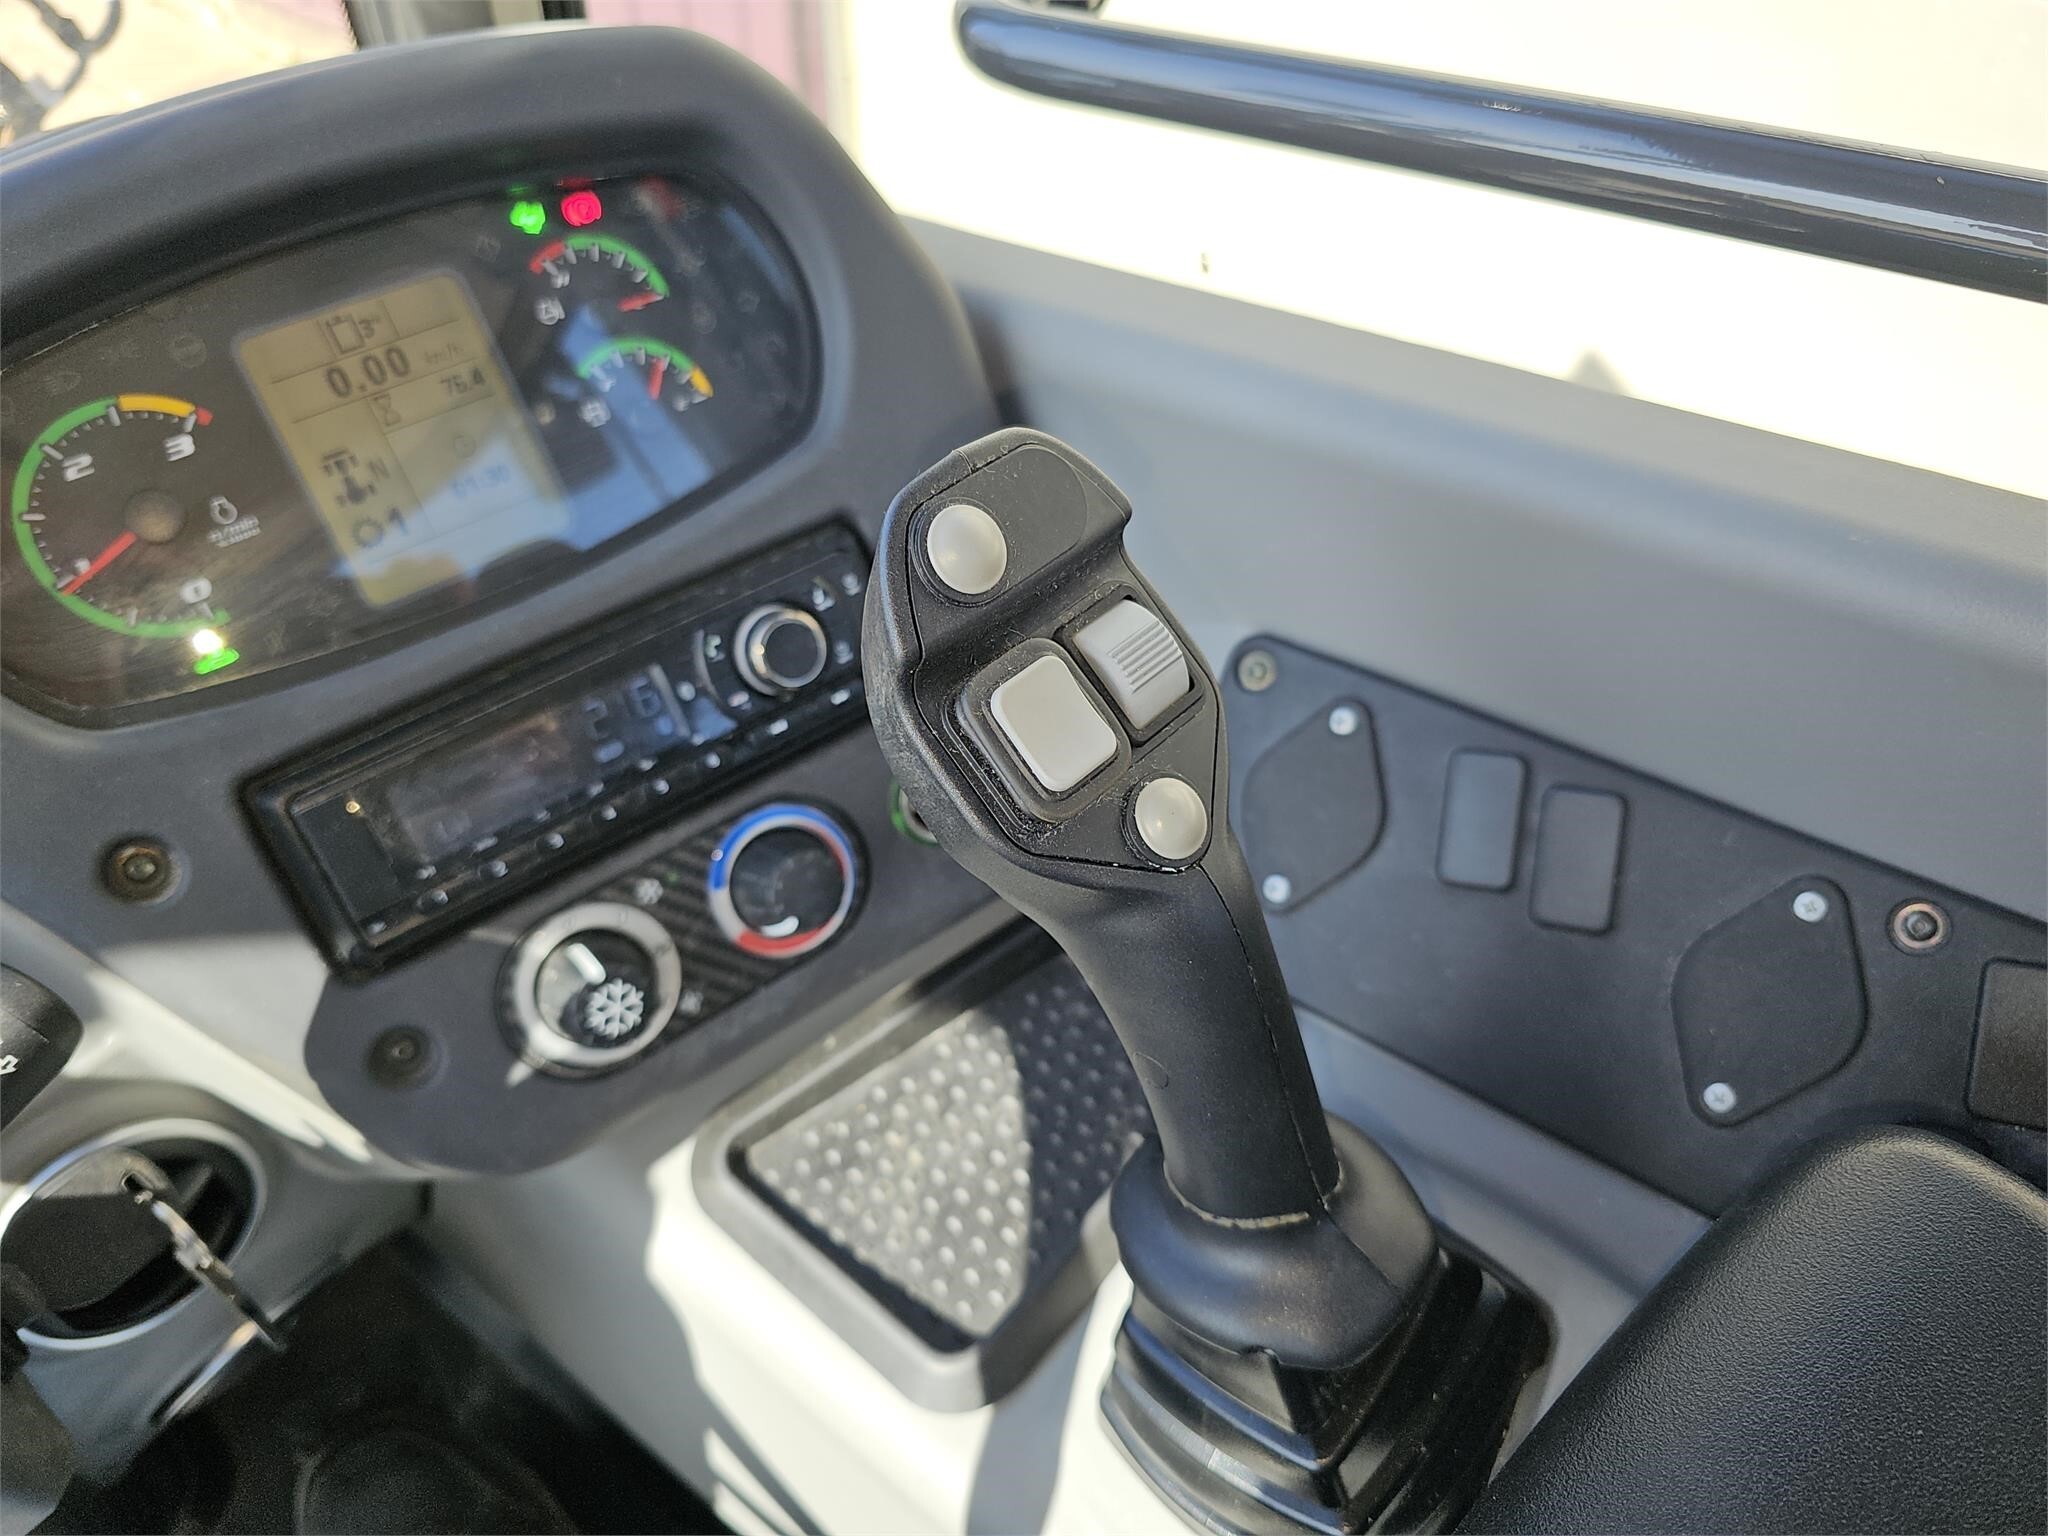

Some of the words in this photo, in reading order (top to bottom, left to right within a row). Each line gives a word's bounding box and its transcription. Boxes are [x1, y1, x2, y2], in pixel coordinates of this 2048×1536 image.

[325, 346, 411, 398] 0.00
[164, 433, 195, 461] 3
[62, 453, 95, 481] 2
